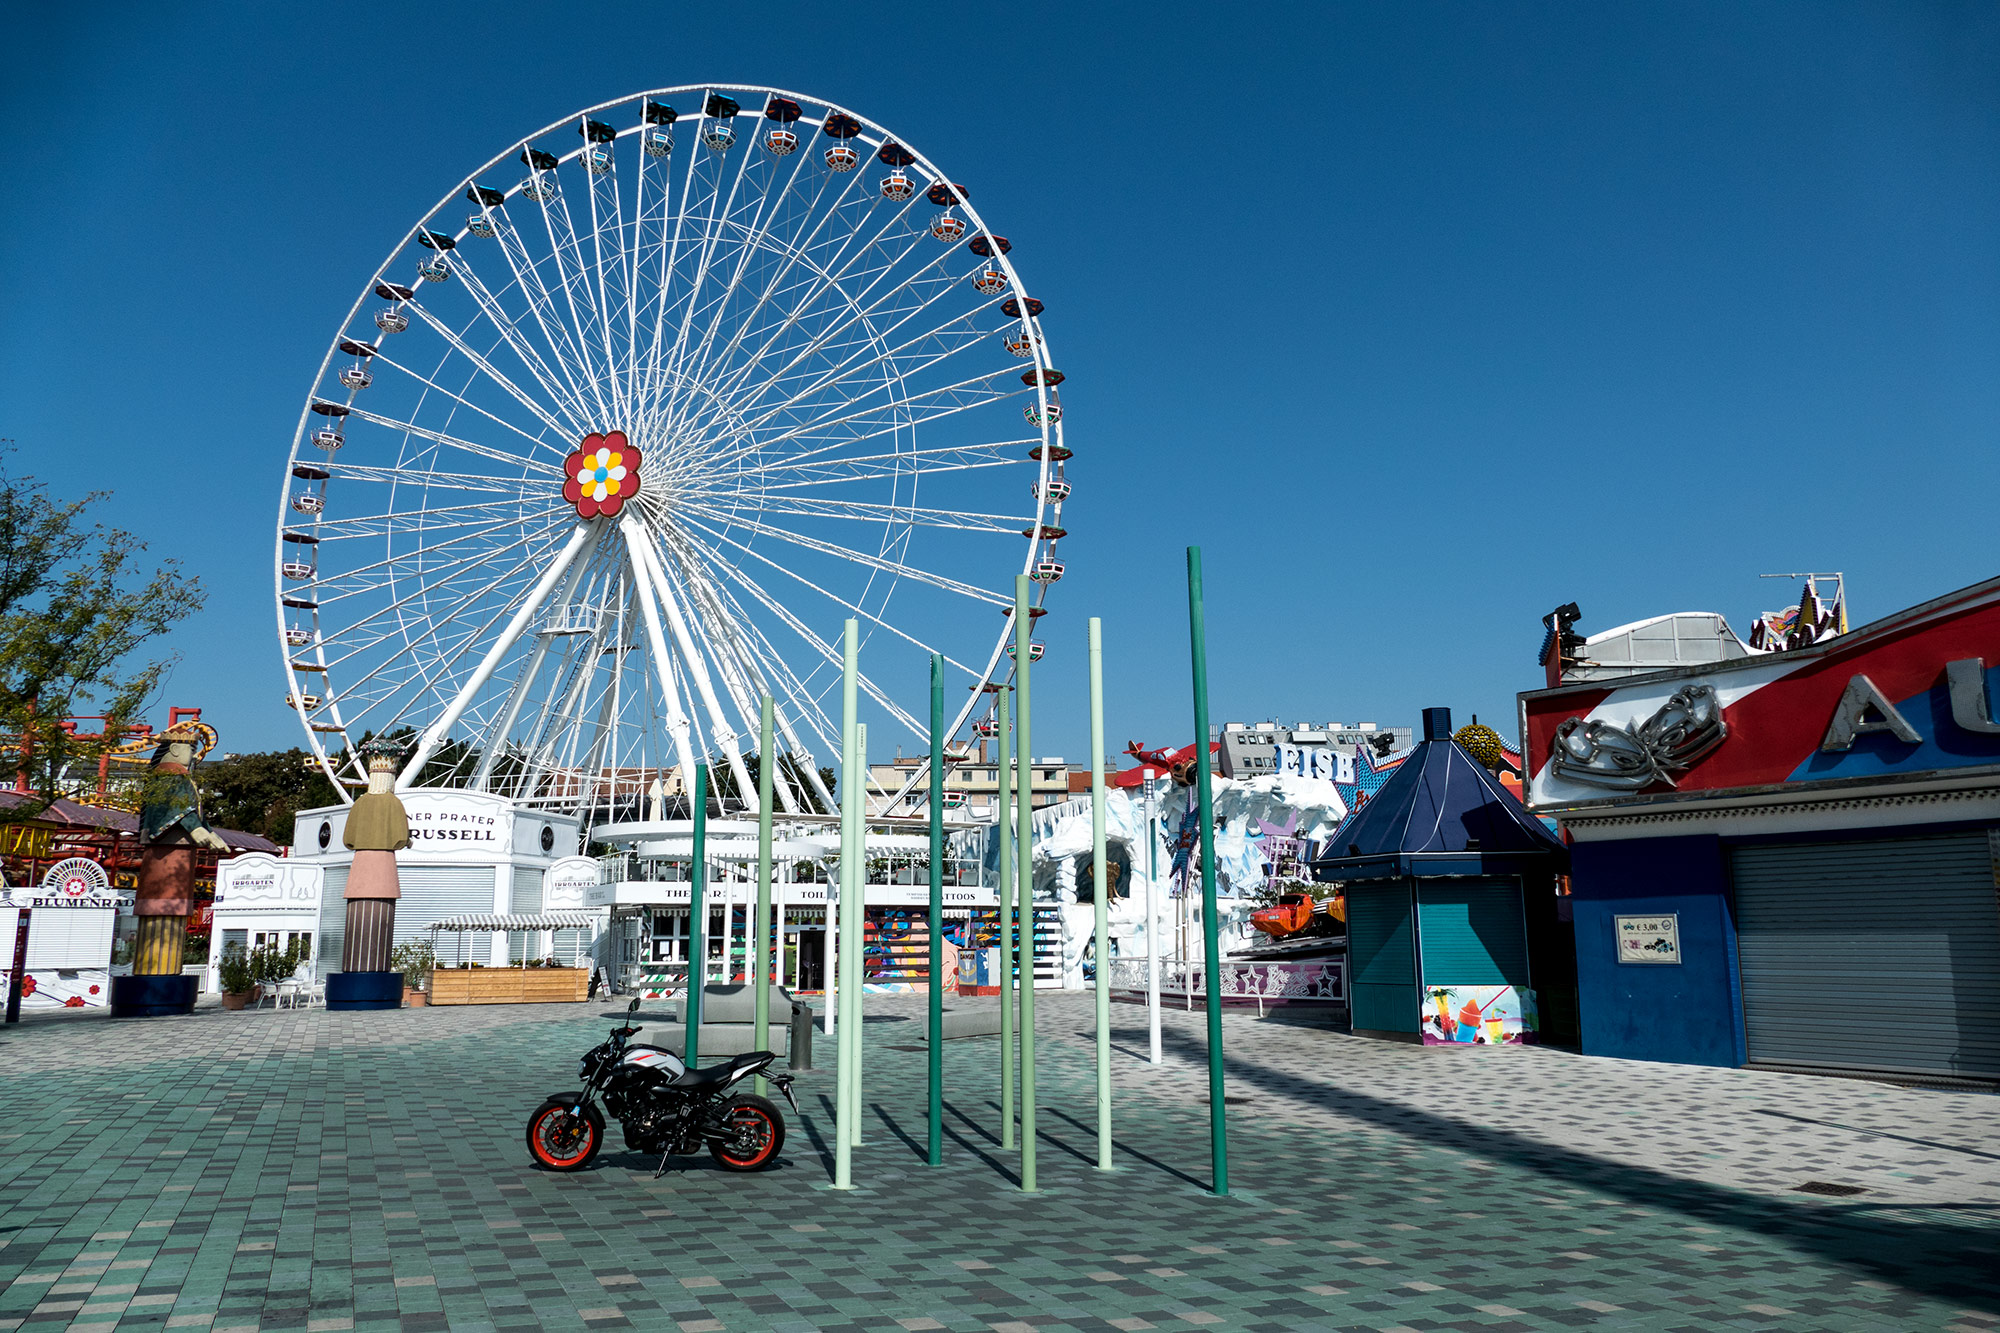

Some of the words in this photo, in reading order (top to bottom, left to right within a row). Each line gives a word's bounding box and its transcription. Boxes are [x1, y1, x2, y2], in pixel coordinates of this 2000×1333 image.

[1273, 742, 1356, 784] EISB
[440, 812, 495, 826] PRATER
[665, 889, 691, 898] THE
[33, 897, 135, 908] BLUMENRAD
